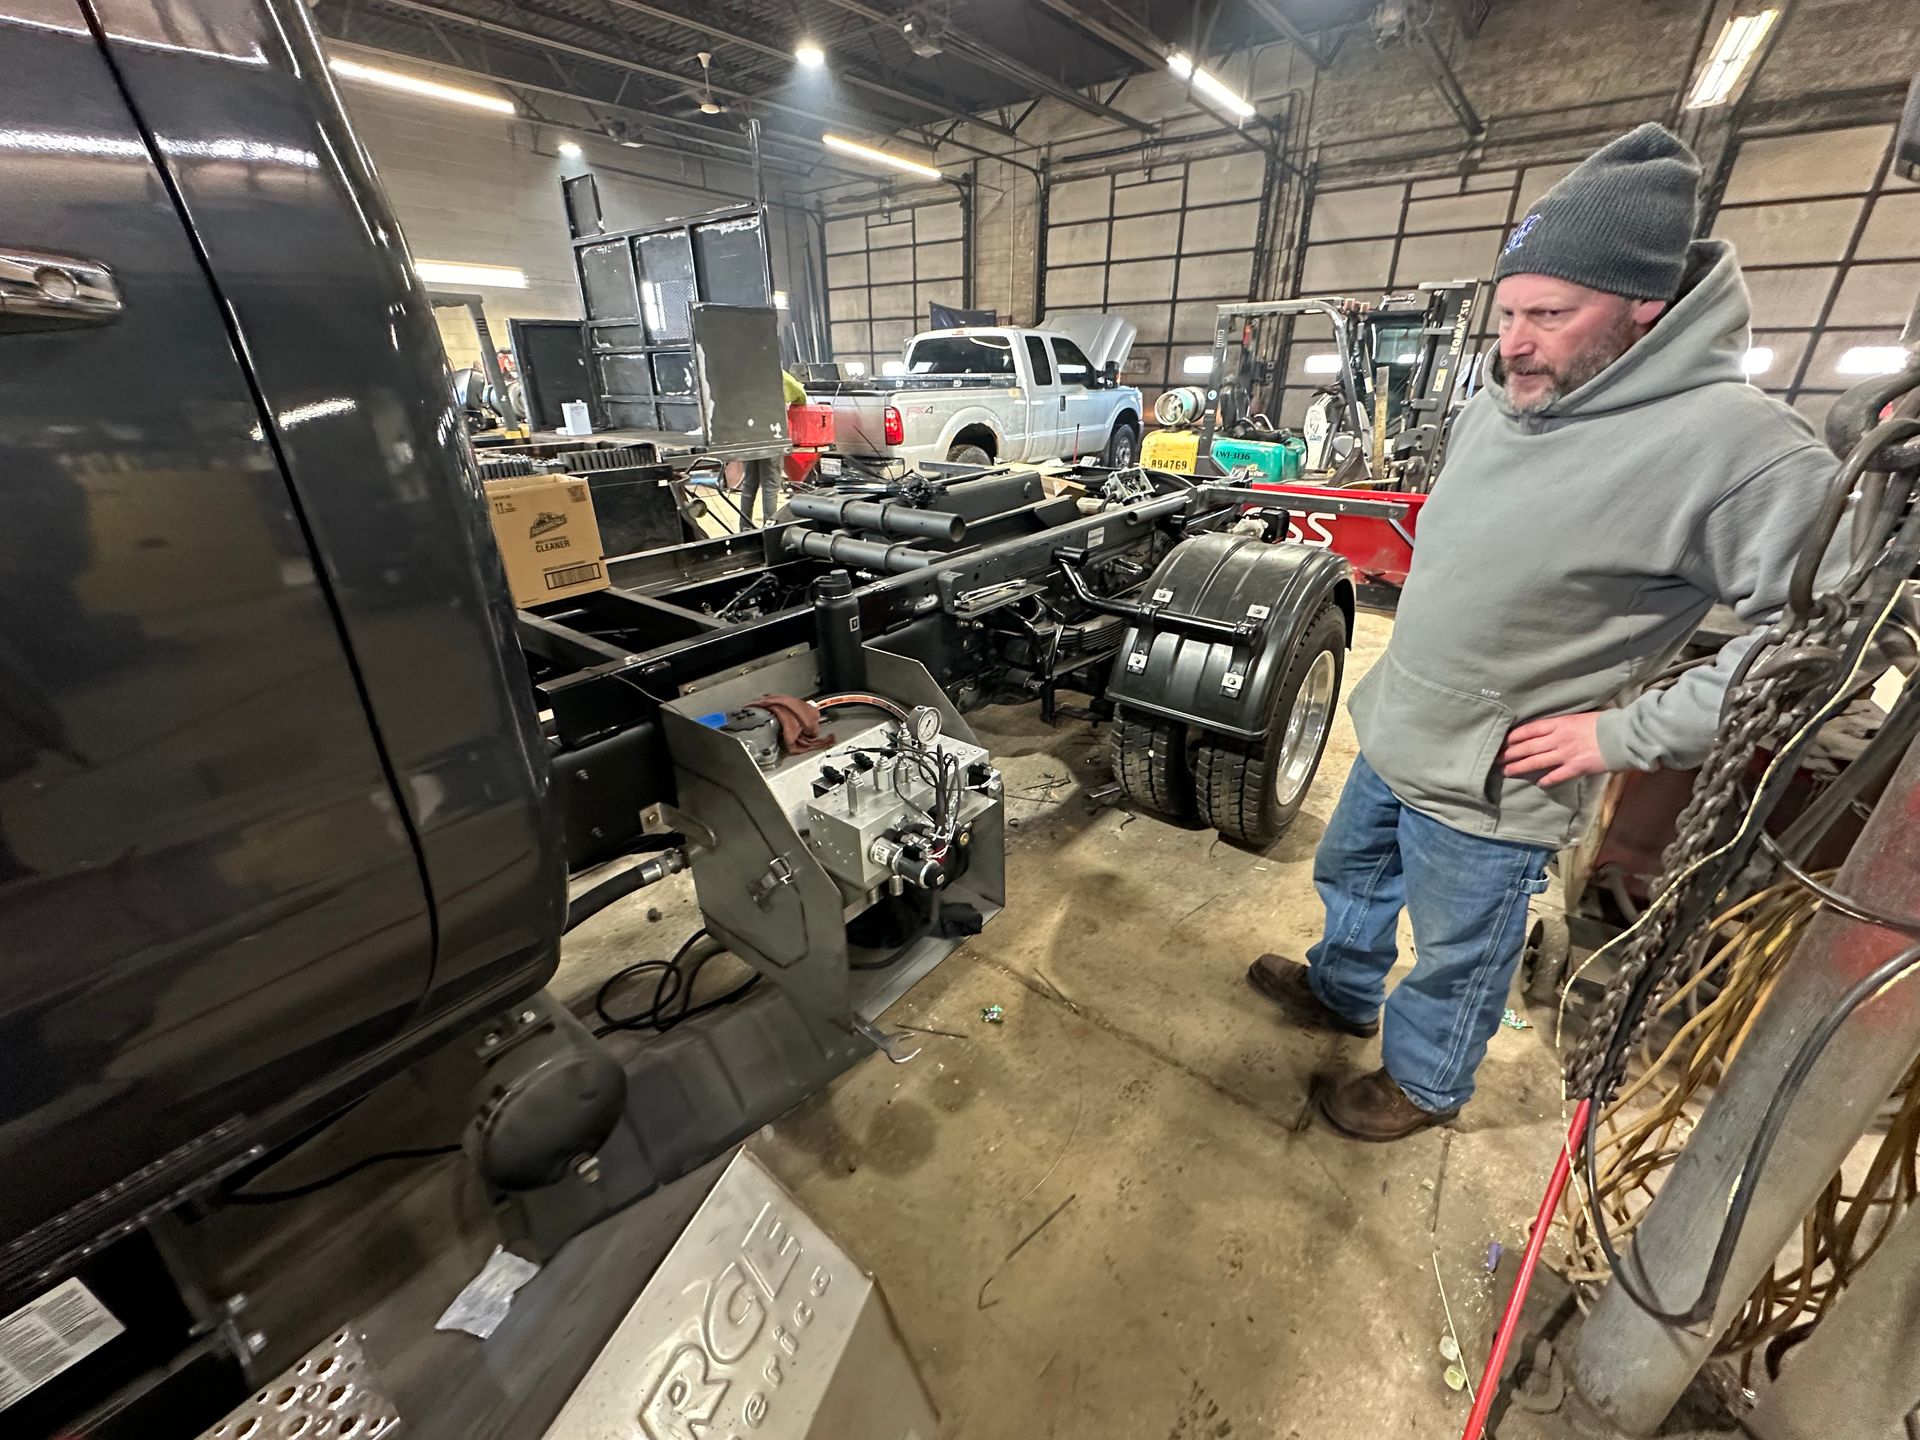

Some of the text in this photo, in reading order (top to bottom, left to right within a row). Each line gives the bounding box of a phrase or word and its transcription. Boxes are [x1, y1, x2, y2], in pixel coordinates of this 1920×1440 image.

[1449, 299, 1472, 356] KOMATSU
[535, 540, 570, 553] CLEANER
[727, 1265, 833, 1440] erica
